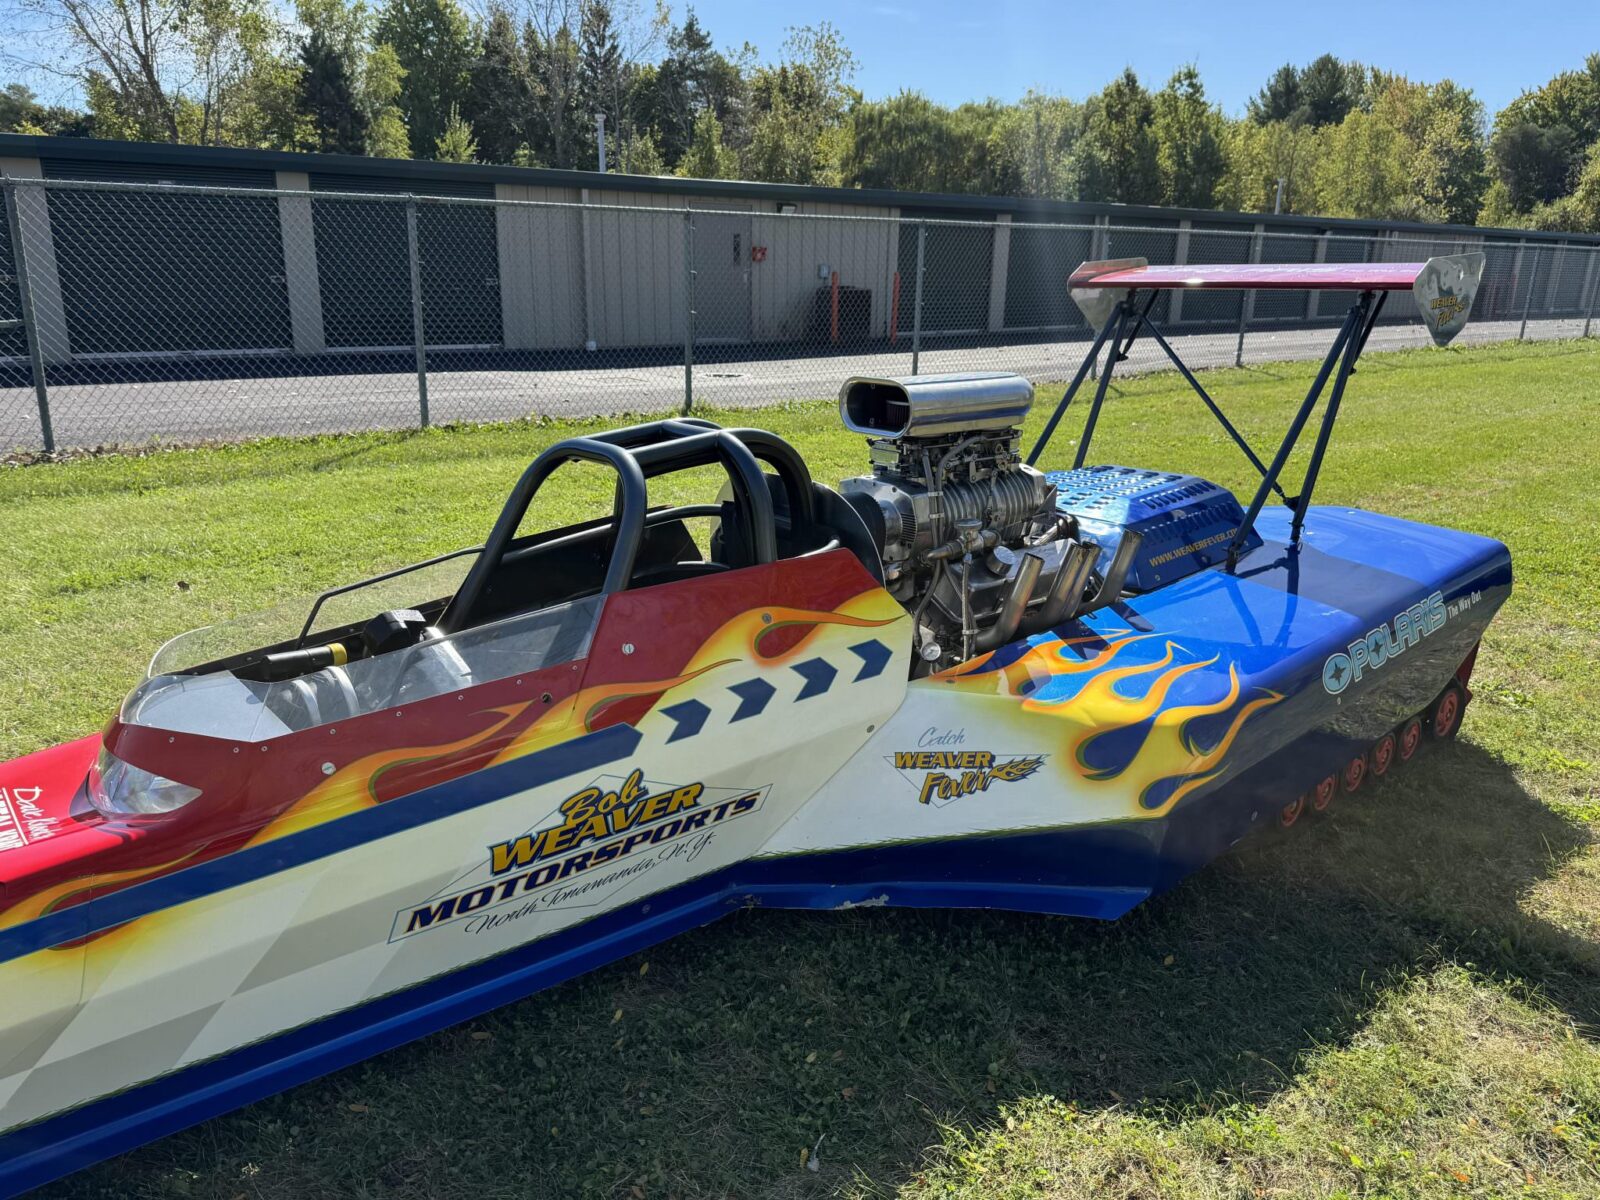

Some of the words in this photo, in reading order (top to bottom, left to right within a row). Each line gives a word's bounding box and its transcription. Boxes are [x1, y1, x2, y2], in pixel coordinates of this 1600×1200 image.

[1448, 604, 1459, 619] The
[1458, 597, 1471, 612] Way
[1471, 590, 1482, 604] Out
[1347, 591, 1447, 682] POLARIS
[918, 726, 965, 748] Catch
[895, 751, 996, 769] WEAVER
[558, 768, 648, 827] Bob
[918, 768, 993, 804] Fever
[488, 782, 704, 876] WEAVER
[405, 791, 762, 933] MOTORSPORTS
[464, 896, 540, 934] North
